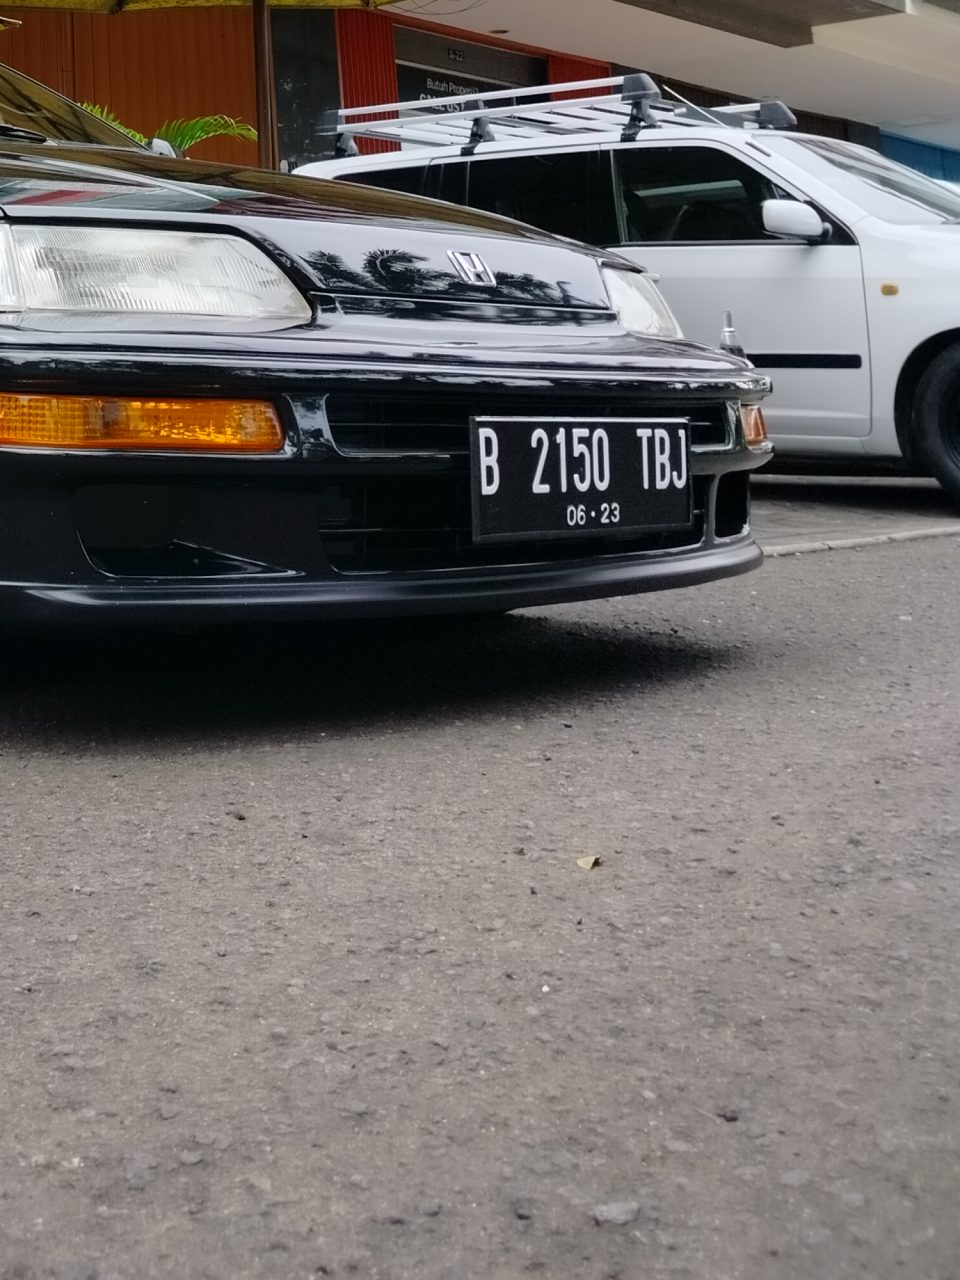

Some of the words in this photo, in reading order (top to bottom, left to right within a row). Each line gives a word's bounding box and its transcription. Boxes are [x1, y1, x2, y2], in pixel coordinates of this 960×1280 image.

[478, 427, 500, 496] B
[530, 427, 611, 494] 2150
[636, 428, 687, 490] TBJ
